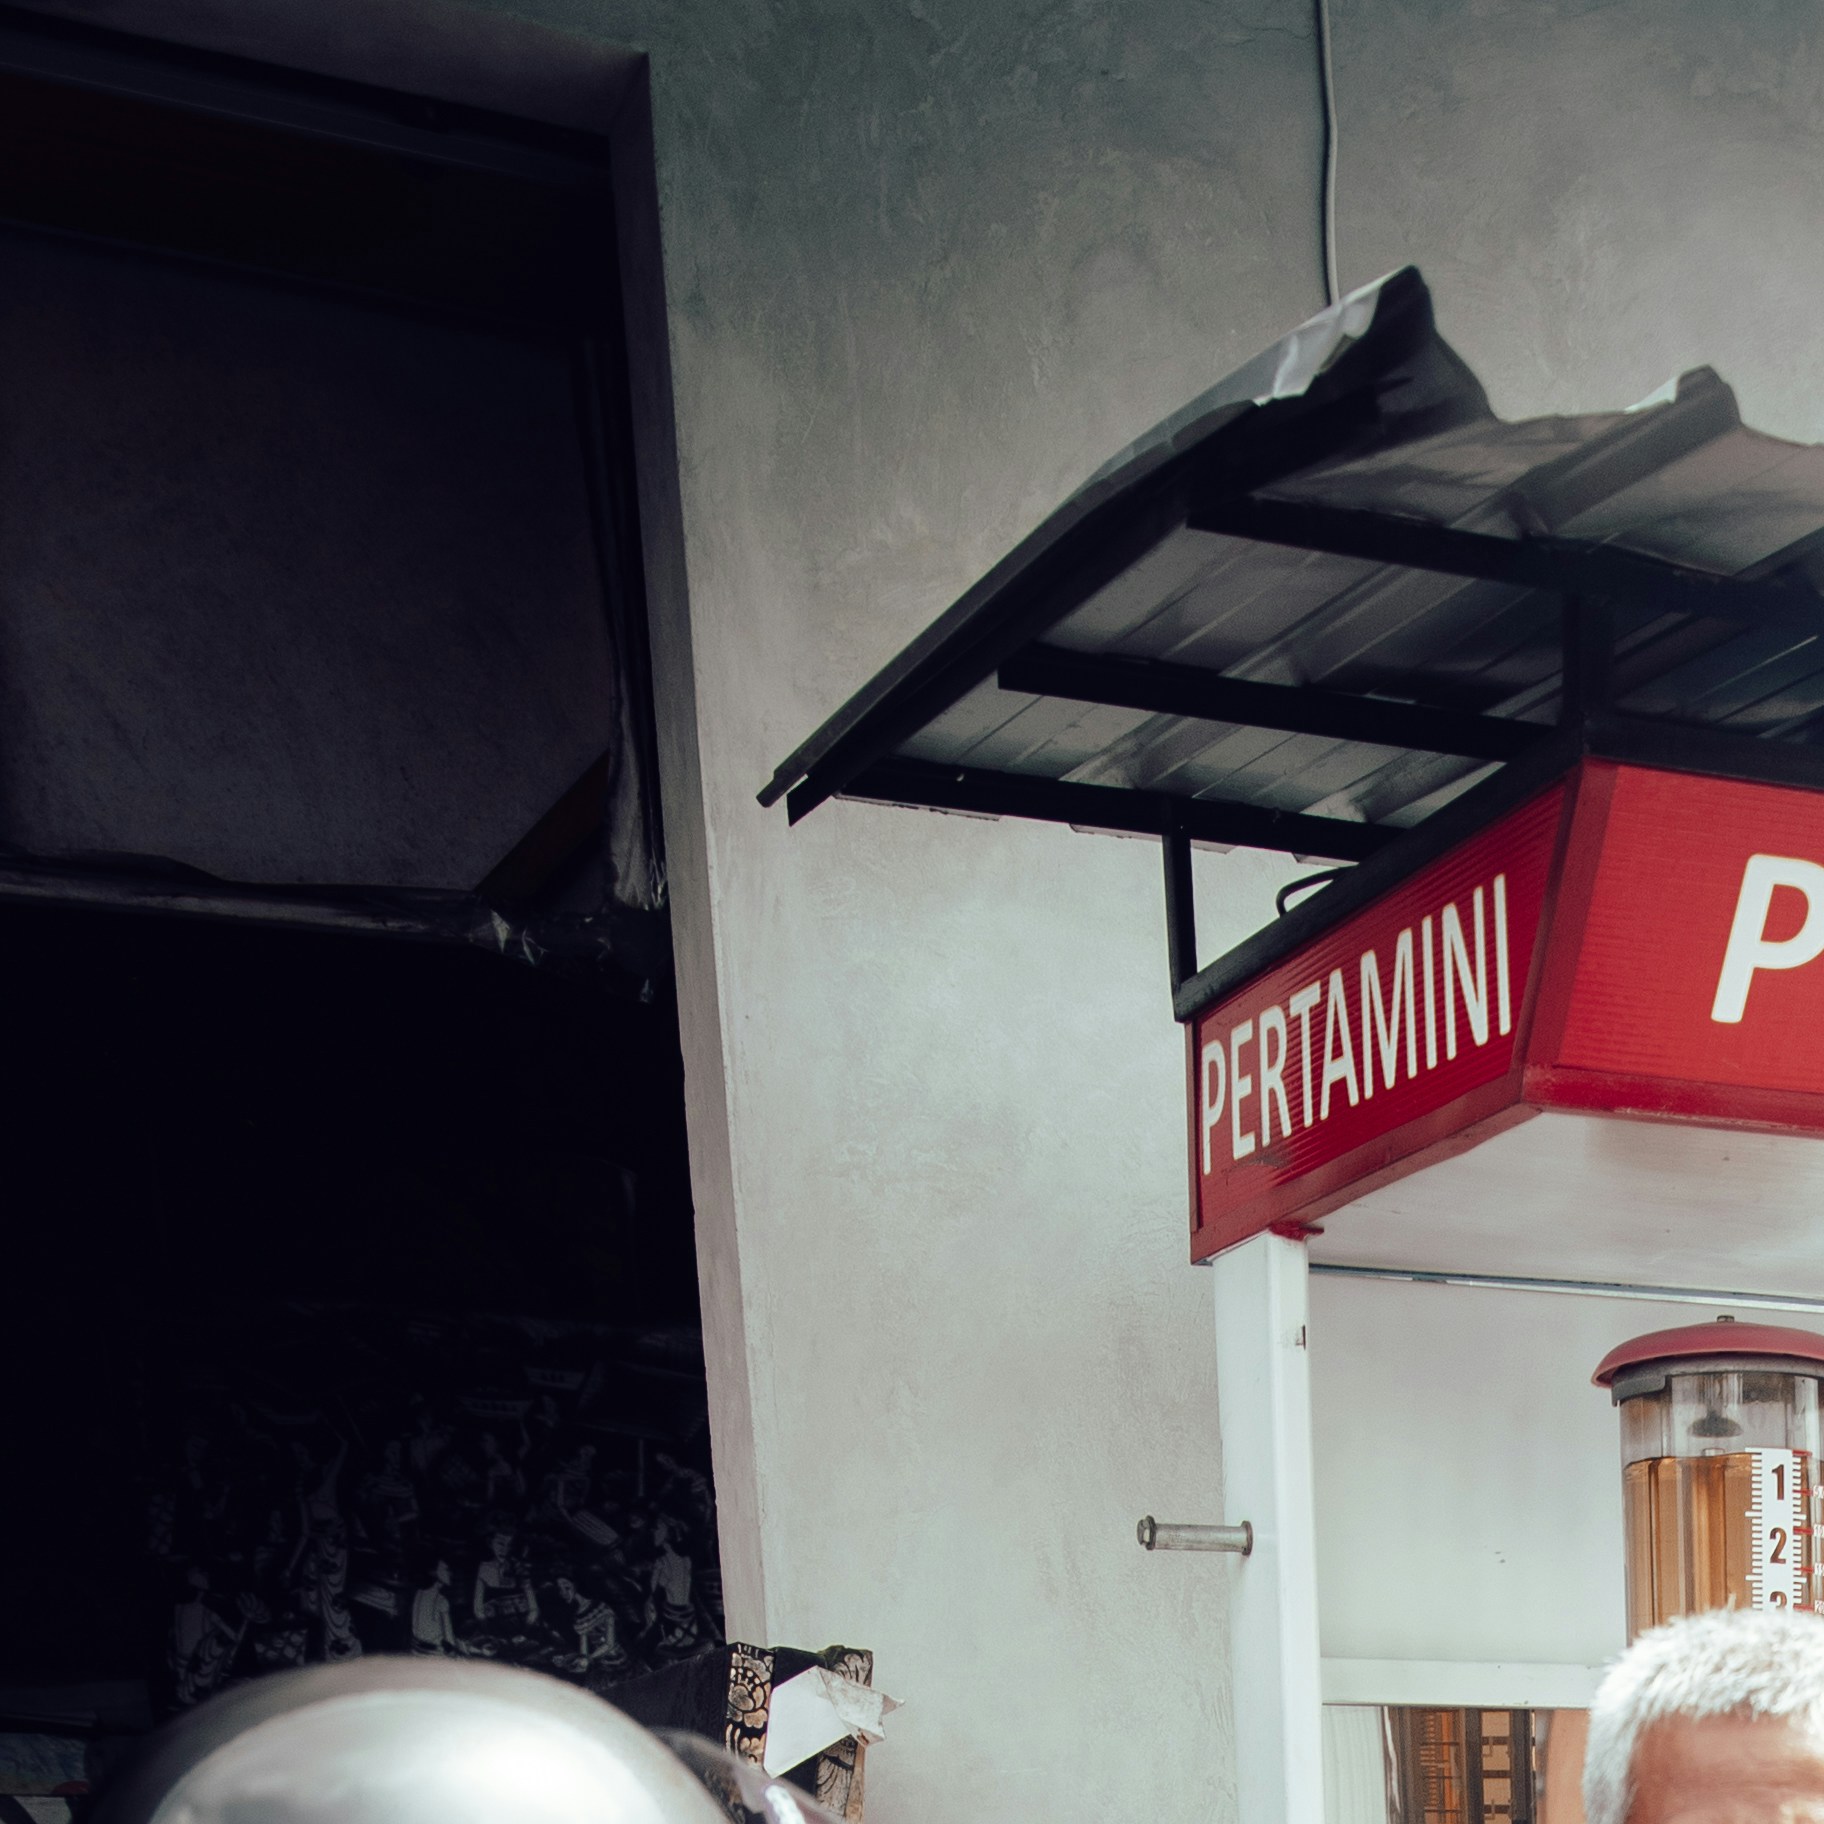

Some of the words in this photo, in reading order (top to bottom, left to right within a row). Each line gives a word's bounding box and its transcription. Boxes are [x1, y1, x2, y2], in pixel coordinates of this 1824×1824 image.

[1200, 873, 1510, 1175] PERTAMINI
[1771, 1464, 1785, 1501] 1
[1769, 1527, 1787, 1565] 2
